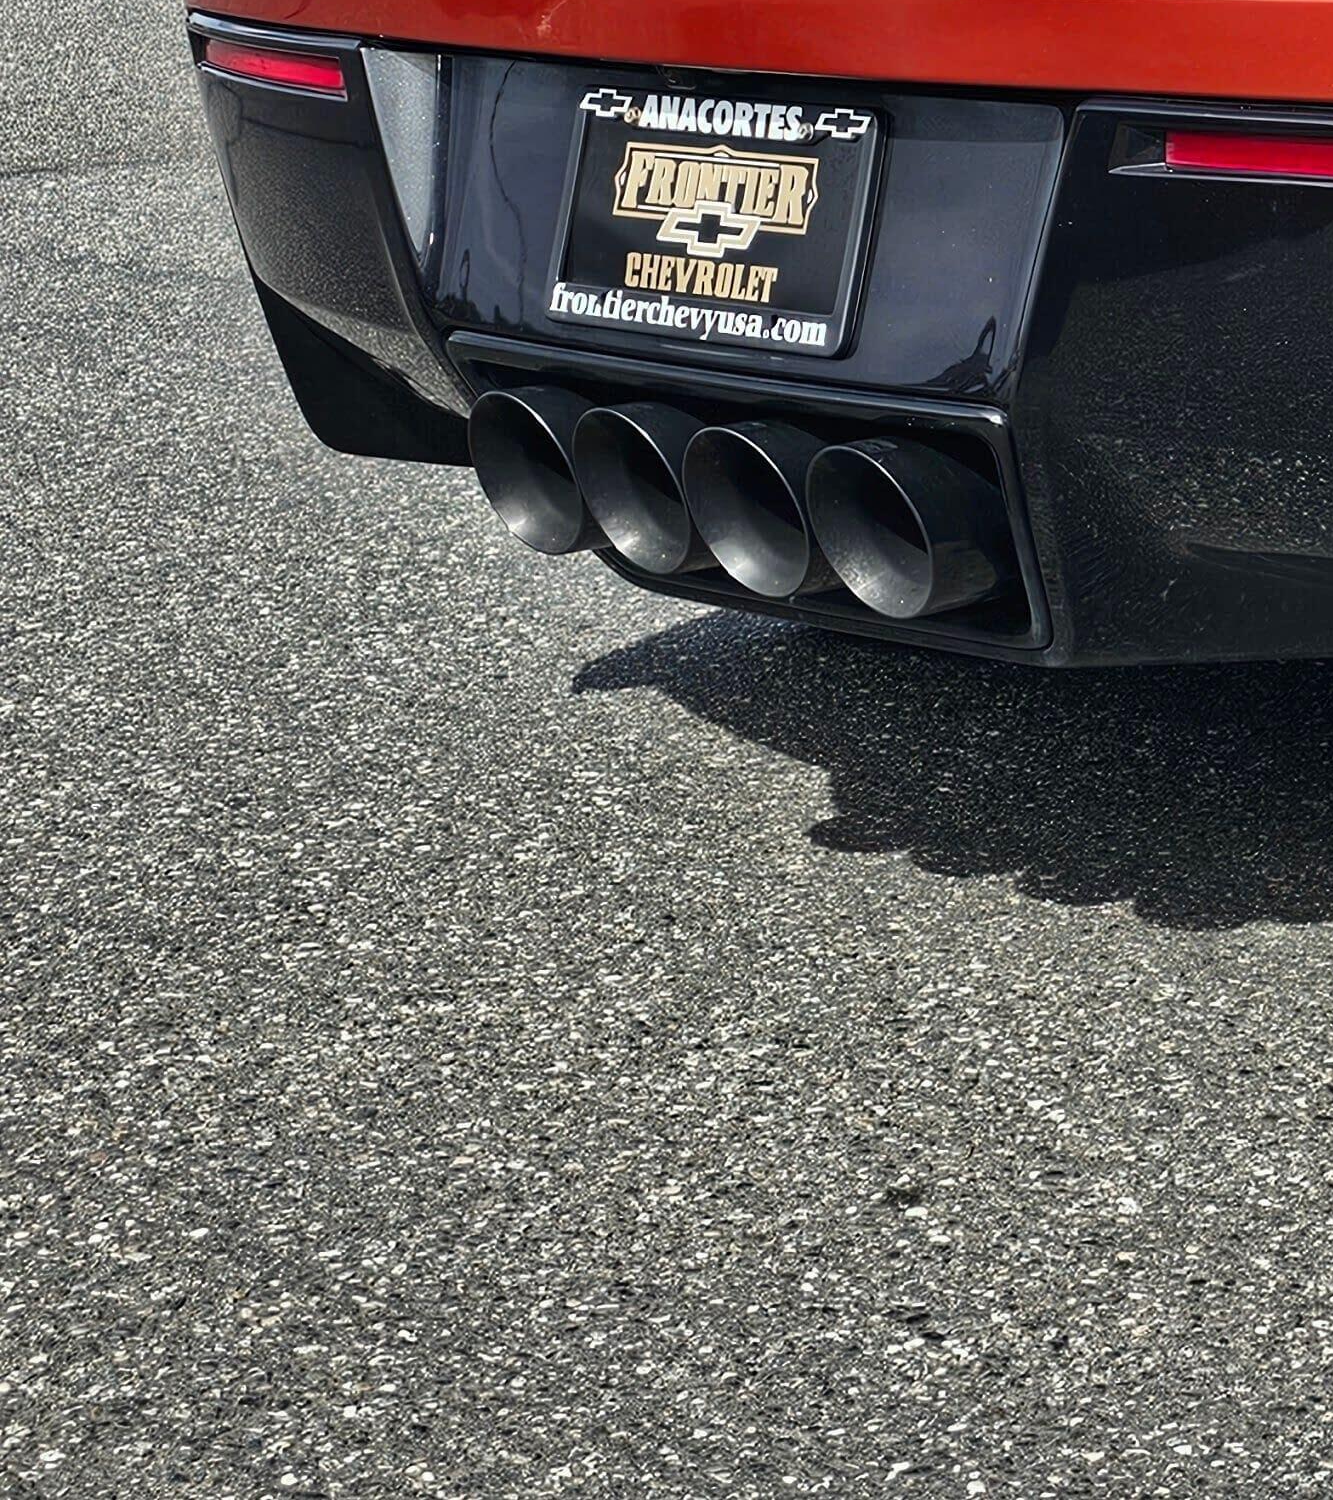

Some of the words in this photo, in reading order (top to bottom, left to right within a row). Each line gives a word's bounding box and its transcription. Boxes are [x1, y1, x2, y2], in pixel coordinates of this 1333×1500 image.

[638, 94, 803, 141] ANACORTES
[621, 151, 809, 225] FRONTIER
[624, 252, 778, 303] CHEVROLET
[549, 282, 827, 347] frontierchevyusa.com
